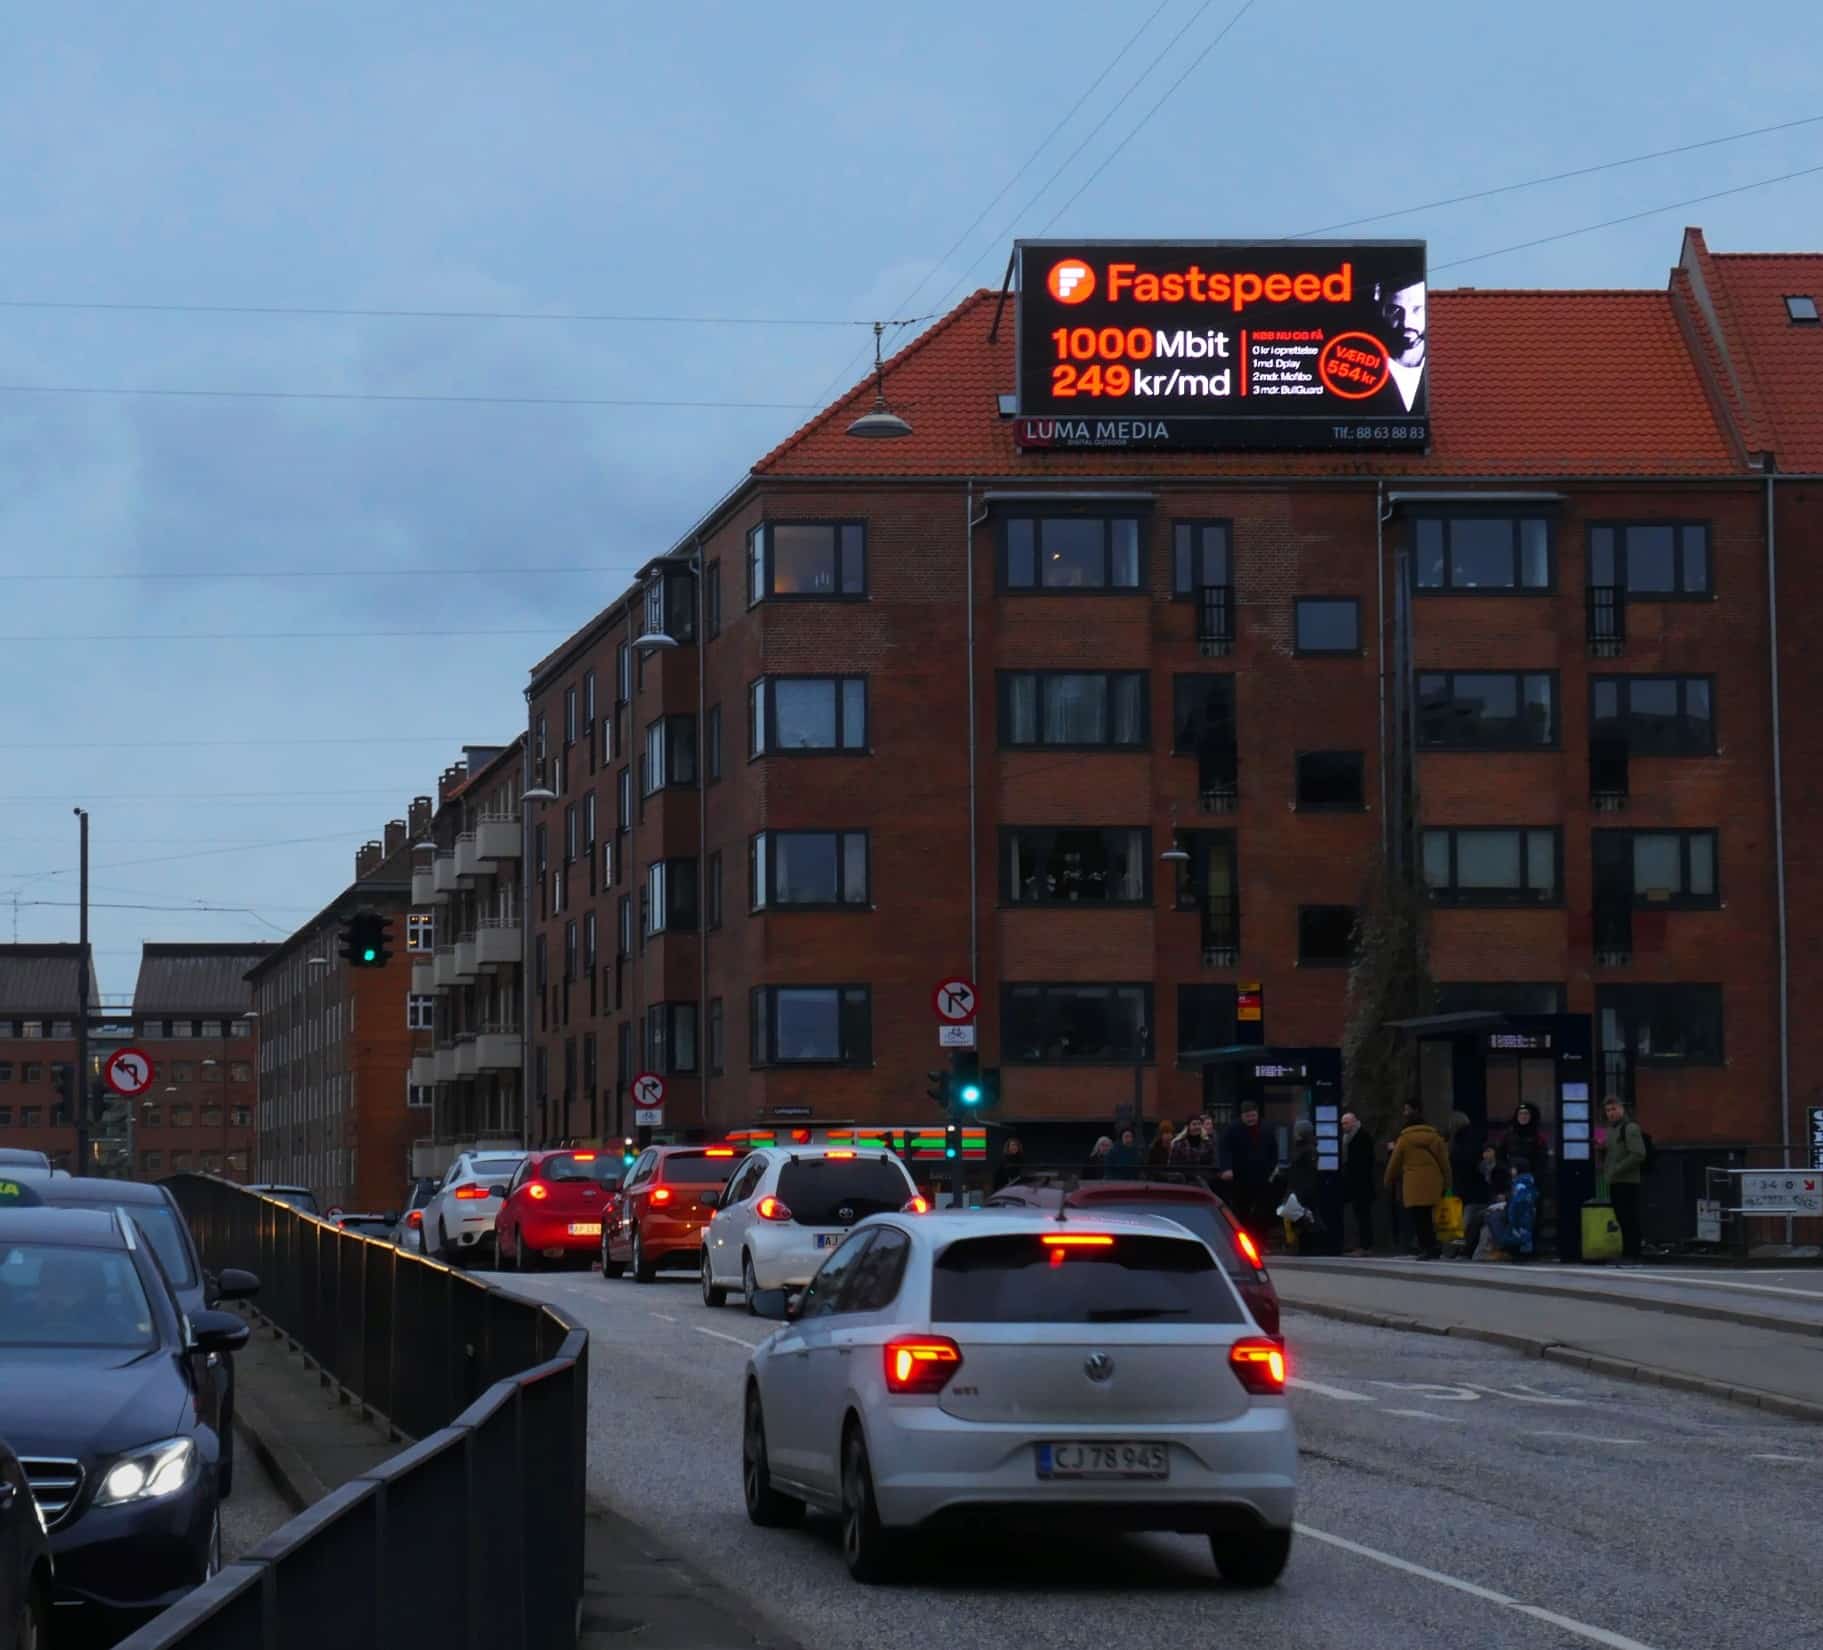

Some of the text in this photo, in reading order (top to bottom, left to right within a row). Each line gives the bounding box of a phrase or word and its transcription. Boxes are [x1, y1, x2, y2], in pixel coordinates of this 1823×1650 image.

[1107, 263, 1352, 312] Fastspeed
[1052, 328, 1230, 360] 1000 Mbit
[1275, 359, 1301, 370] Dplay
[1336, 345, 1380, 369] VÆRDI
[1051, 365, 1230, 397] 249 kr/md
[1326, 359, 1377, 385] 554 kr
[1026, 421, 1170, 439] LUMA MEDIA
[1356, 426, 1372, 439] 88
[1374, 426, 1390, 439] 63
[1392, 426, 1407, 439] 88
[1410, 426, 1425, 439] 83
